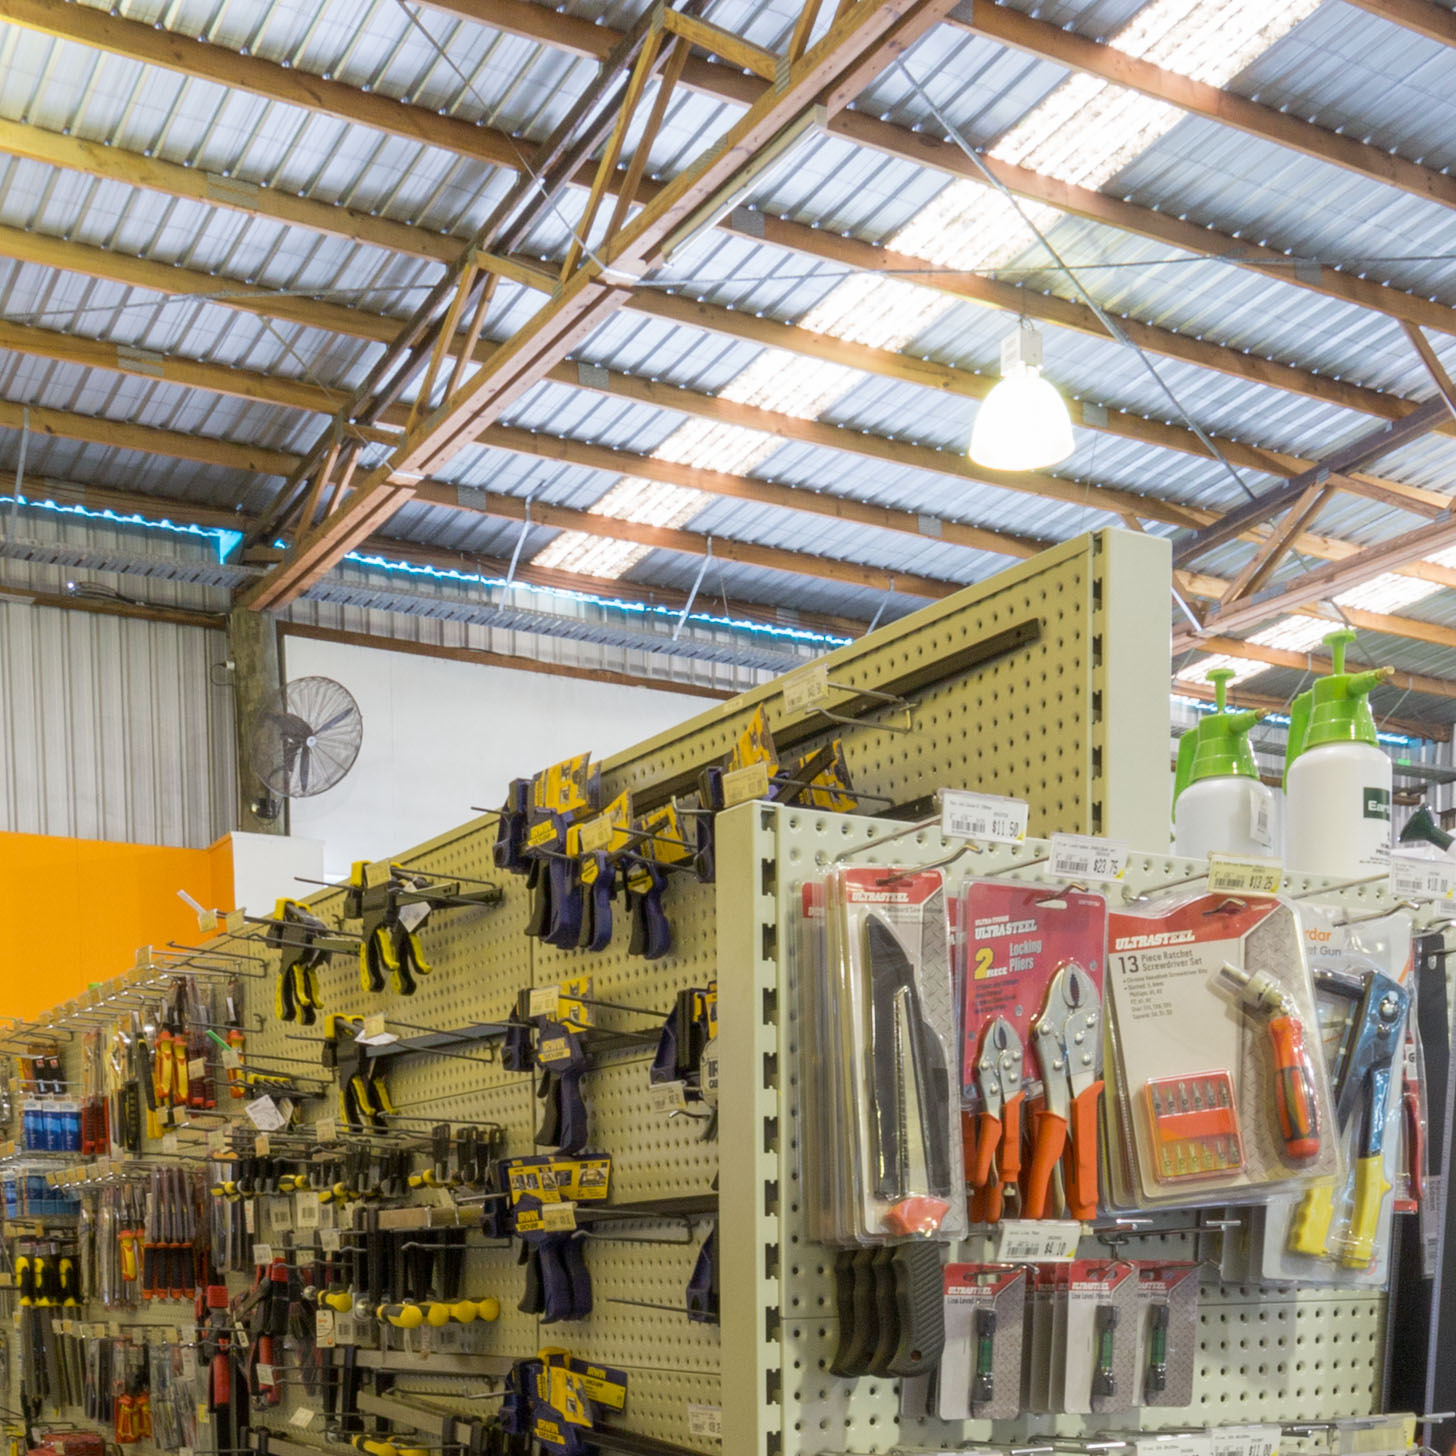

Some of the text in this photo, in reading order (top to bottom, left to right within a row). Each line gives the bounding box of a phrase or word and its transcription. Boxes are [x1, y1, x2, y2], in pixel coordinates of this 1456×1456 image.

[992, 820, 1019, 838] $11.50
[1094, 857, 1119, 876] $23.75
[1249, 874, 1274, 890] $13.25
[851, 889, 909, 902] ULTRASTEEL
[974, 919, 1037, 940] ULTRASTEEL
[1009, 939, 1042, 957] Locking
[1115, 930, 1196, 950] ULTRASTEEL
[1141, 949, 1193, 962] Piece Ratchet
[1320, 945, 1342, 957] Gun
[974, 948, 994, 980] 2
[1009, 956, 1034, 973] Pliers
[1118, 956, 1139, 974] 13
[1142, 957, 1203, 972] Screwdriver Set
